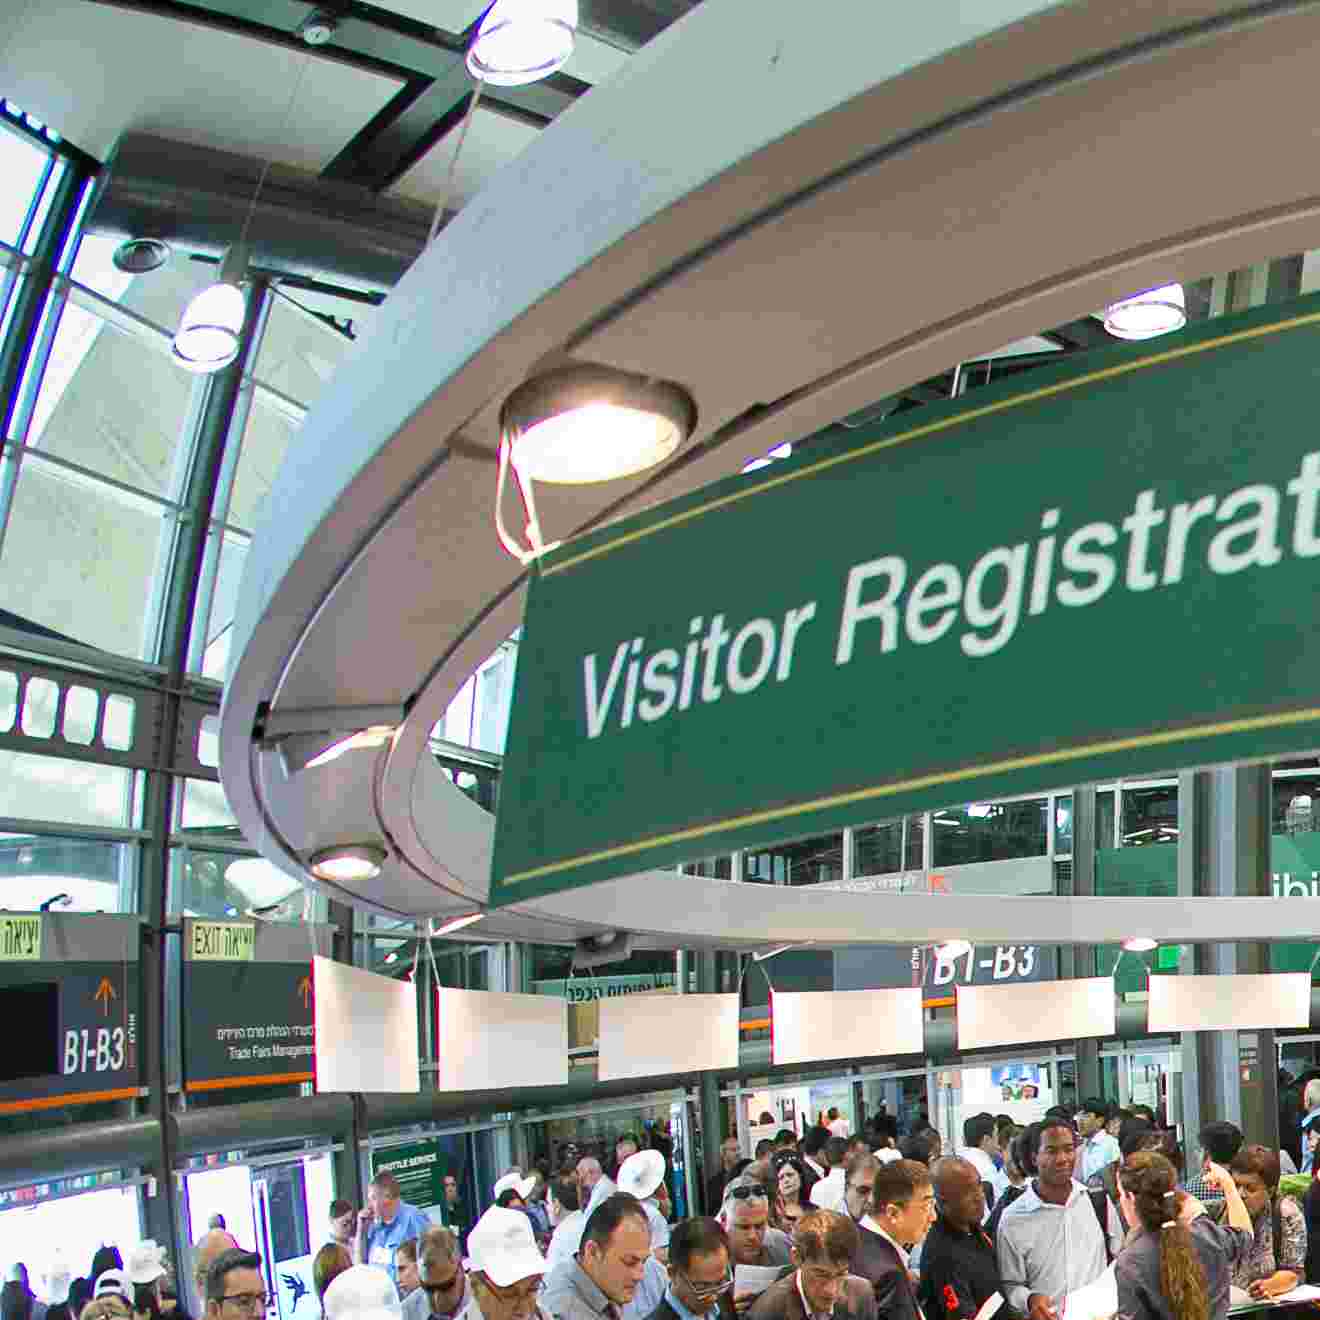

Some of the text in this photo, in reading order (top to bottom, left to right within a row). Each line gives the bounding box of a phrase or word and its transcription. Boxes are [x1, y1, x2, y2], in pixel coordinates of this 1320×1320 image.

[582, 603, 818, 738] Visitor
[195, 925, 222, 954] EXIT
[62, 1026, 126, 1076] B1-B3
[272, 1042, 314, 1059] Managemen
